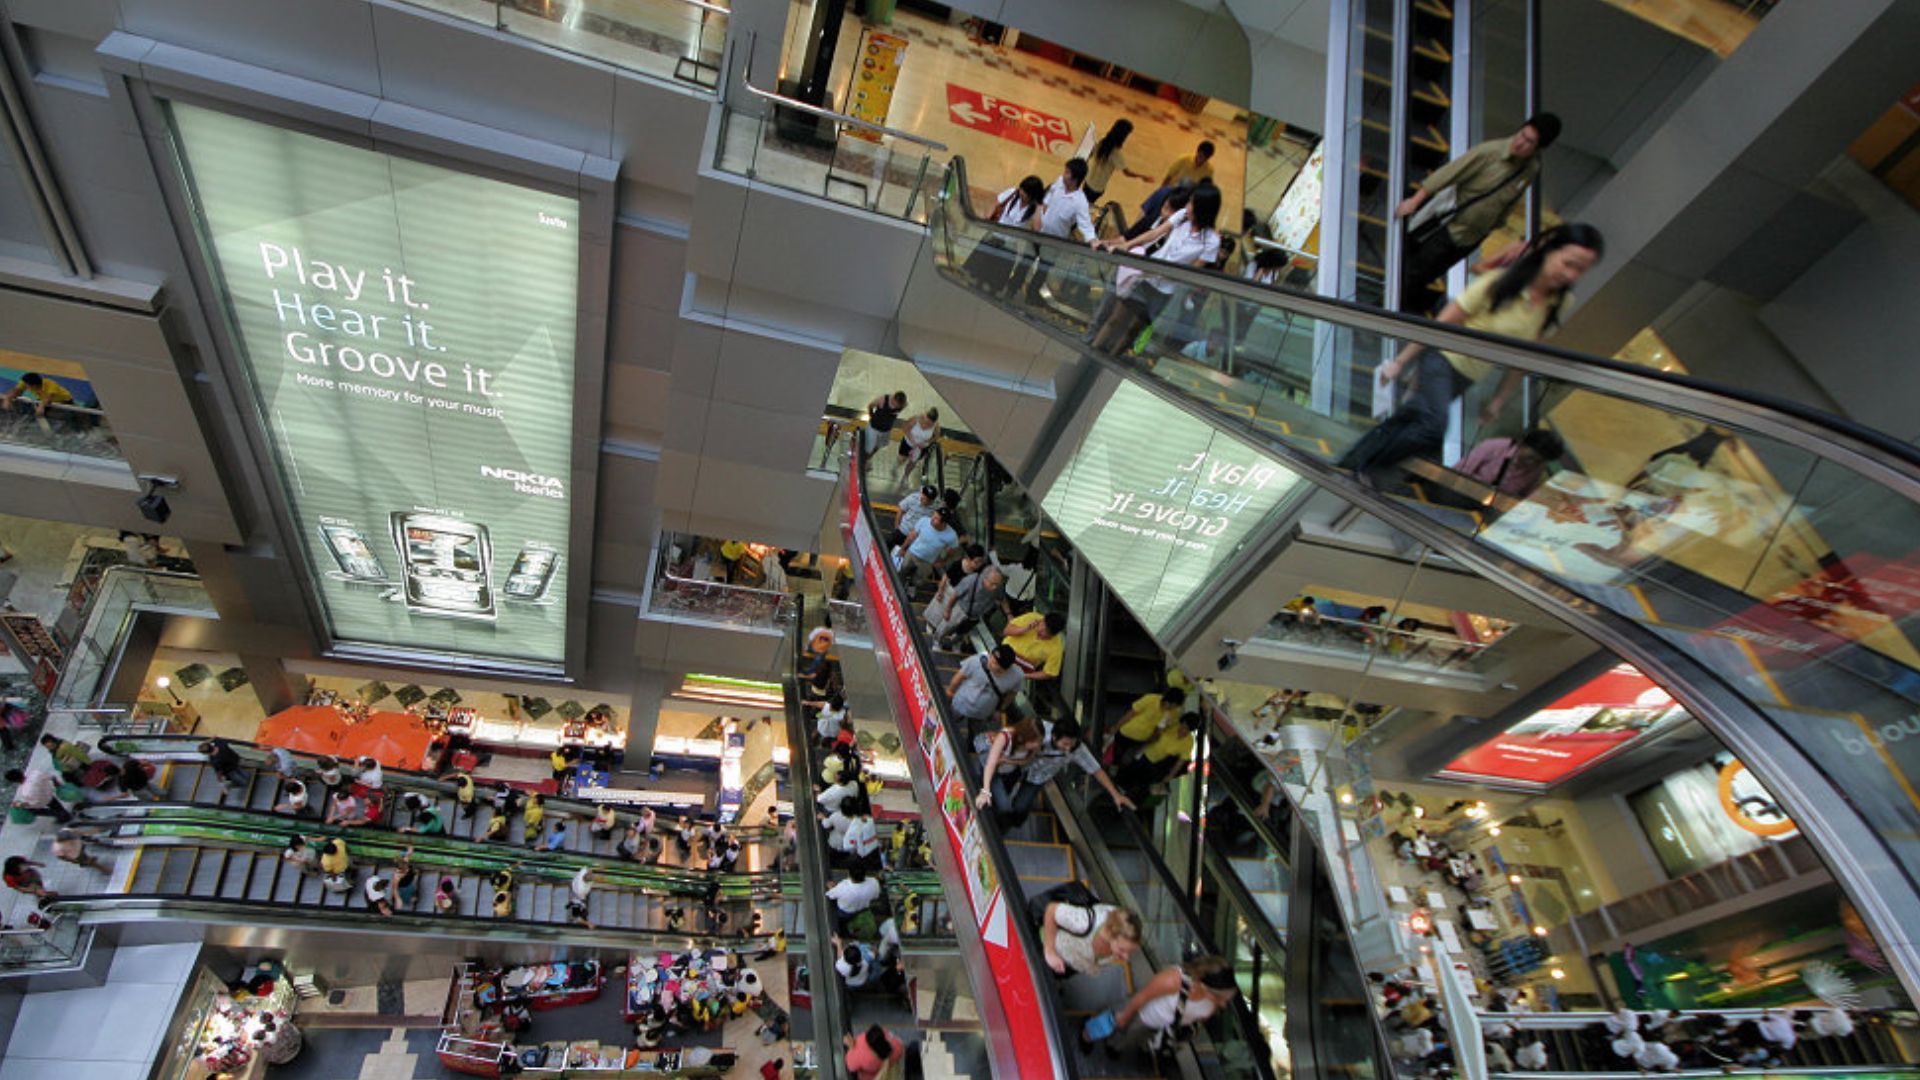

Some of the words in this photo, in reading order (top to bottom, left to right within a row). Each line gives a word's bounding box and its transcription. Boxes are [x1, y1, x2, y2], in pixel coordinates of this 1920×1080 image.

[982, 93, 1069, 136] Food
[259, 241, 365, 301] Play
[383, 267, 429, 310] it.
[272, 289, 387, 339] Hear
[402, 314, 446, 351] it.
[286, 332, 447, 387] Groove
[462, 361, 504, 397] it.
[297, 373, 334, 389] More
[339, 381, 400, 401] memory
[404, 390, 423, 405] for
[428, 395, 459, 410] your
[463, 402, 504, 419] music
[481, 465, 563, 488] NOKIA
[514, 481, 564, 498] Nseries
